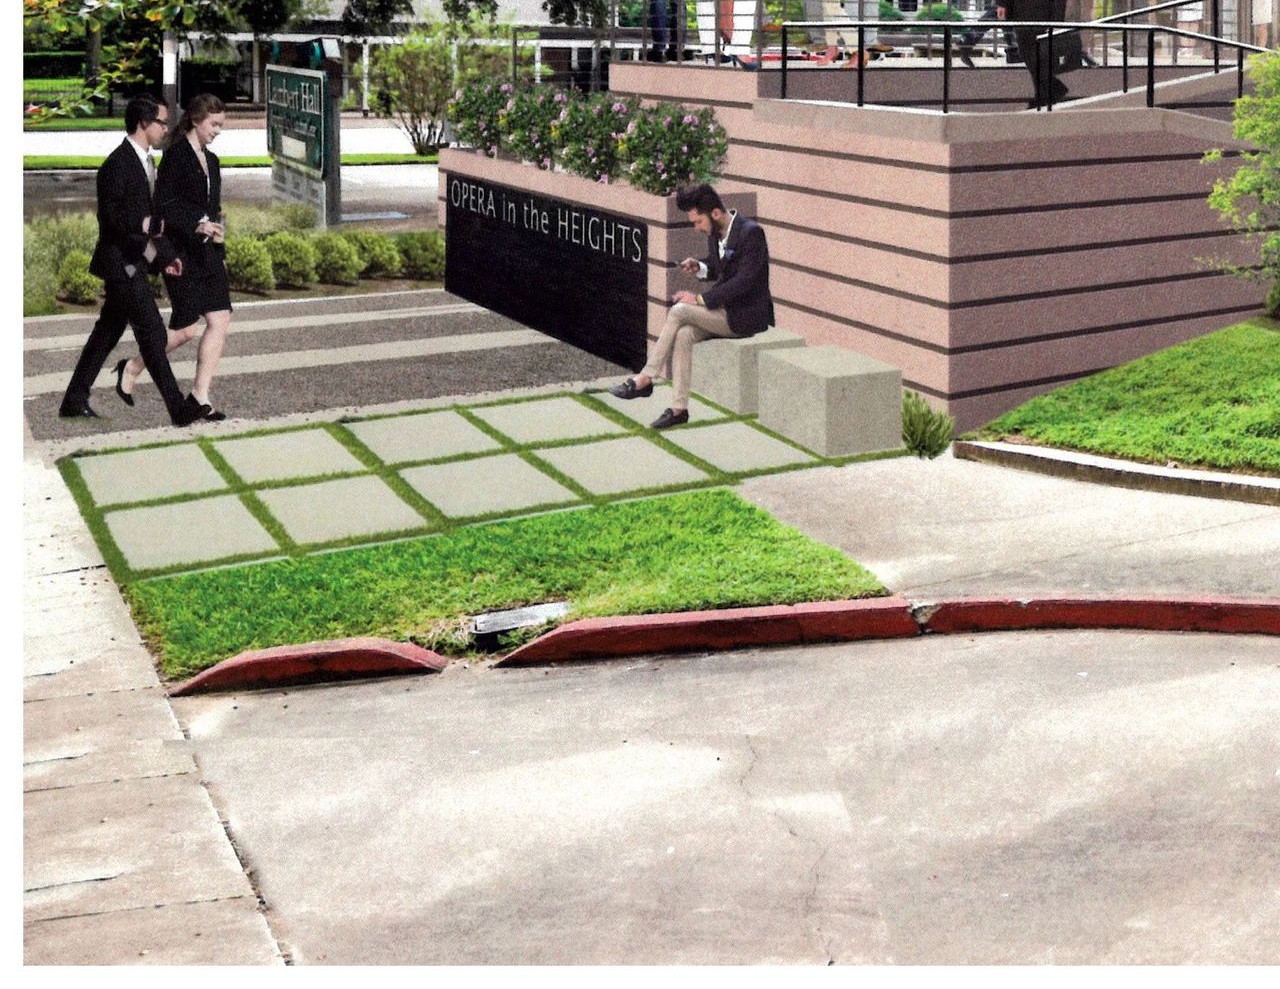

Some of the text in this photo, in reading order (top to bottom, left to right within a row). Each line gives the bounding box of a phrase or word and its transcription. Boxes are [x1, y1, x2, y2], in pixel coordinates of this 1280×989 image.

[301, 82, 321, 115] Hall
[450, 179, 642, 262] OPERA in the HEIGHTS
